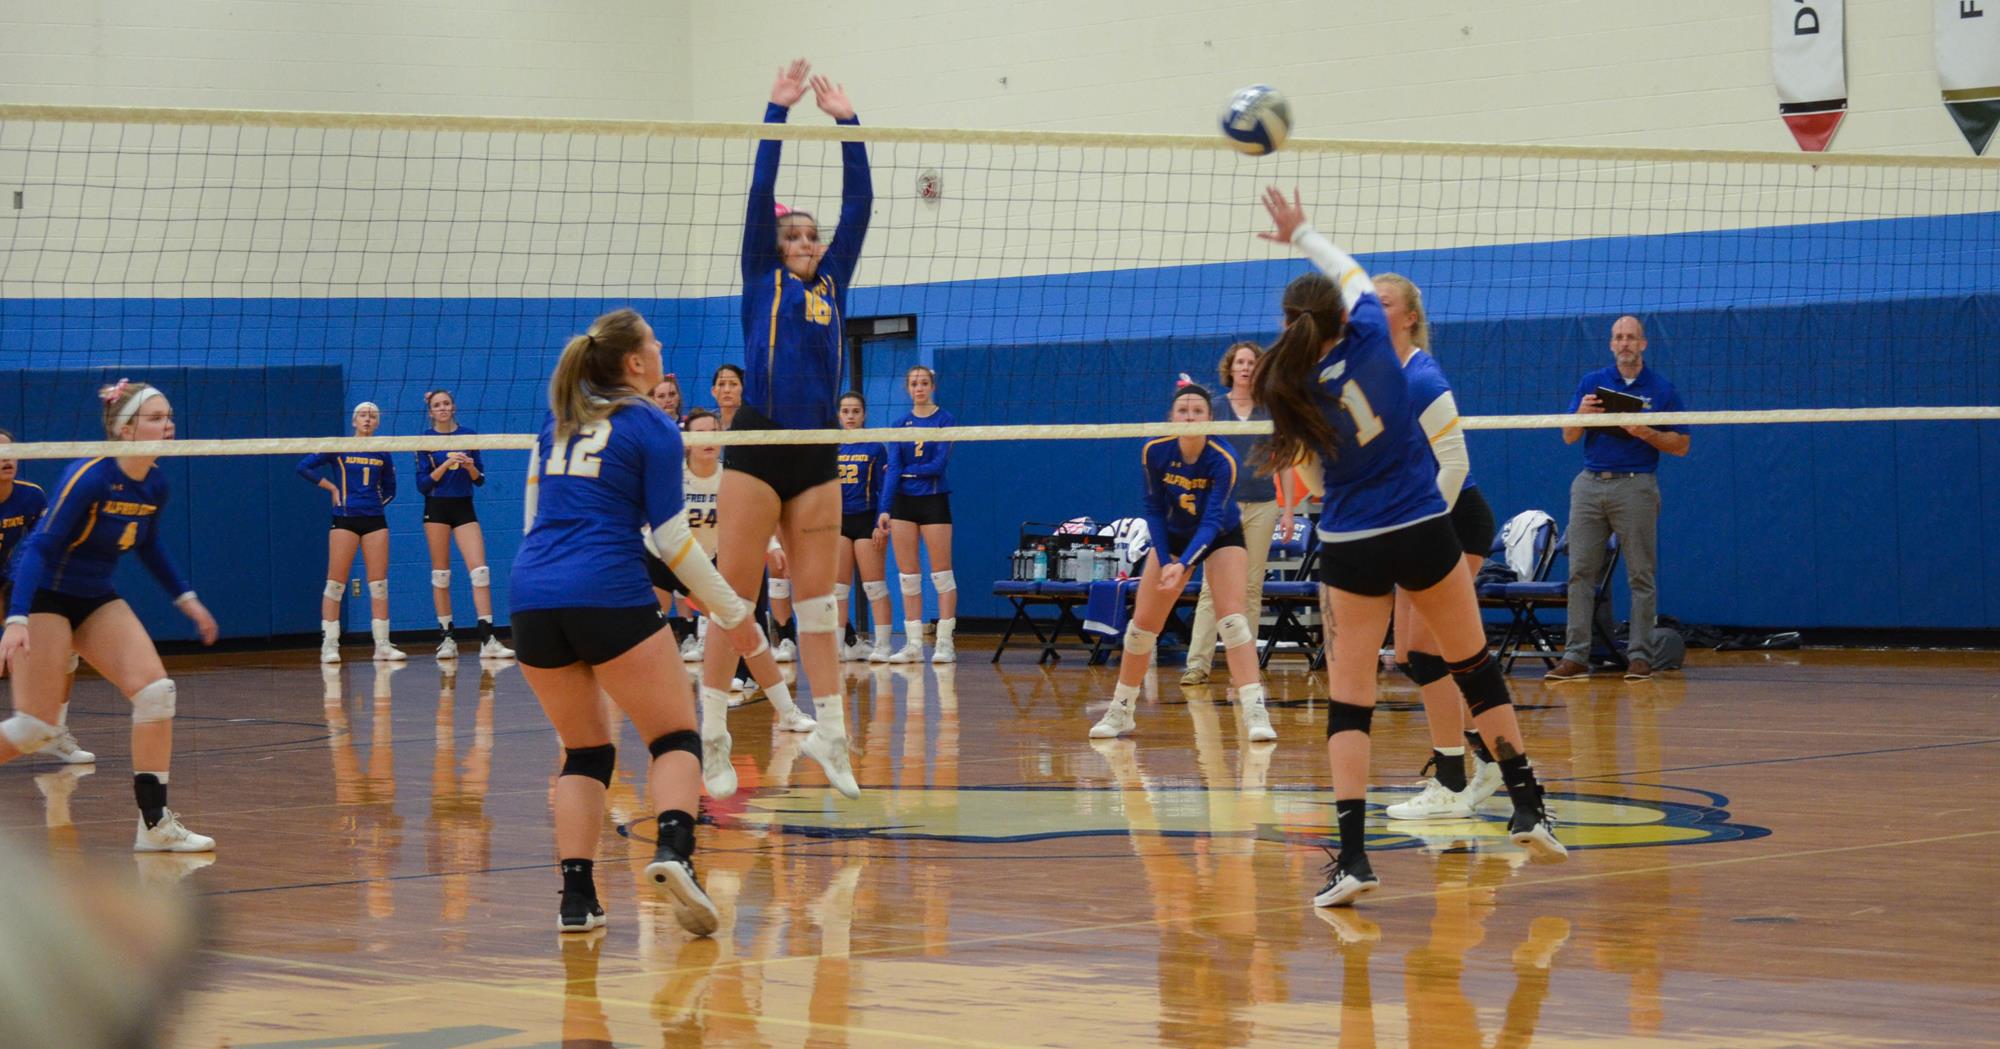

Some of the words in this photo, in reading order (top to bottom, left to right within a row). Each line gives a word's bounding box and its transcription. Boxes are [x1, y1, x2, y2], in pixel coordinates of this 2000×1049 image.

[1340, 379, 1385, 447] 1
[545, 419, 613, 478] 12
[362, 467, 370, 486] 1
[688, 508, 718, 529] 24
[118, 521, 138, 550] 4
